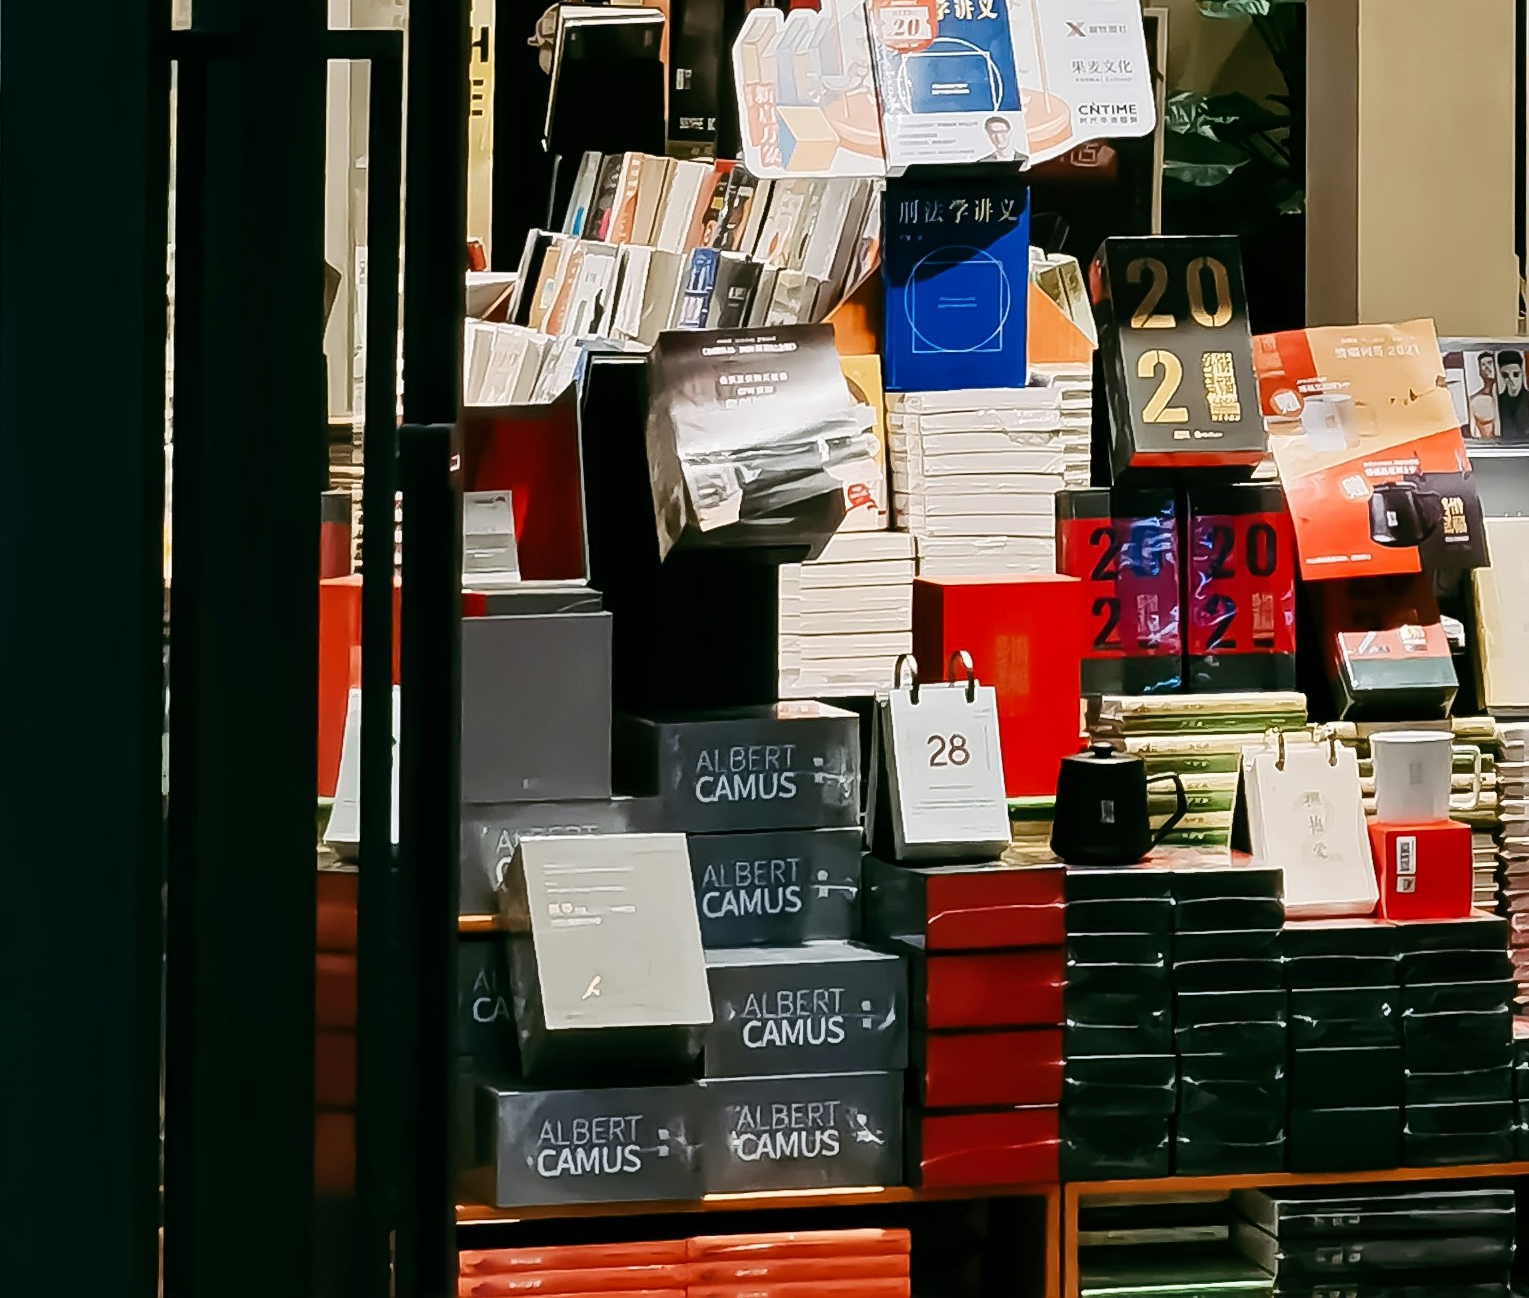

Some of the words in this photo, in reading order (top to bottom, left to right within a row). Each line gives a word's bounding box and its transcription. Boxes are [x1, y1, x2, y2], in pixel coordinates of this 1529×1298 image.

[1125, 256, 1235, 329] 20
[696, 744, 797, 775] ALBERT
[926, 734, 971, 767] 28
[695, 772, 798, 803] CAMUS
[702, 858, 801, 888] ALBERT
[702, 885, 802, 919] CAMUS
[741, 988, 845, 1018] ALBERT
[742, 1018, 845, 1049] CAMUS
[538, 1115, 643, 1145] ALBERT
[737, 1101, 842, 1131] ALBERT
[537, 1145, 642, 1178] CAMUS
[738, 1130, 841, 1163] CAMUS
